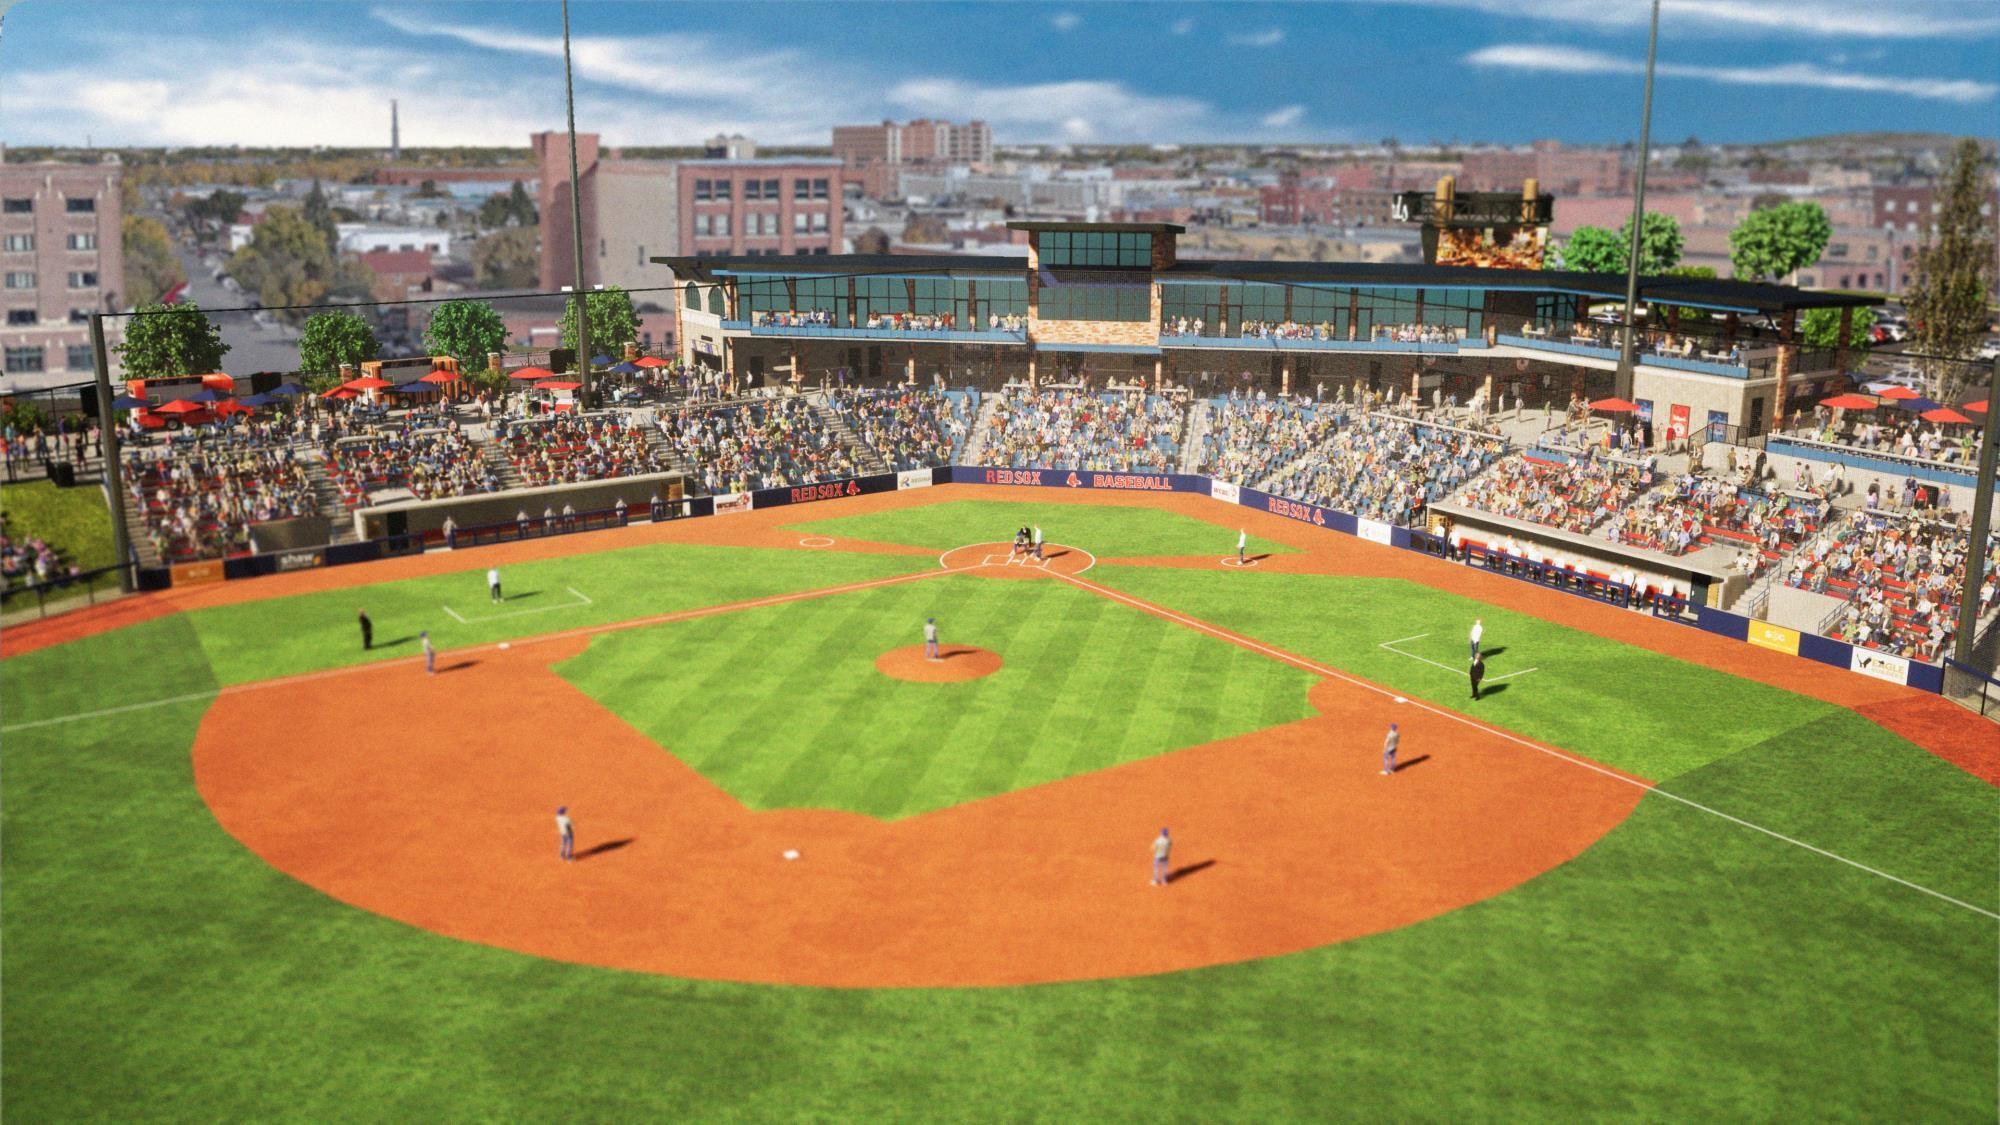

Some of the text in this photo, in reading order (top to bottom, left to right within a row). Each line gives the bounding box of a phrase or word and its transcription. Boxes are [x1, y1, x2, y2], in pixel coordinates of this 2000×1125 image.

[986, 470, 1041, 486] RED SOX
[1094, 474, 1172, 490] BASEBALL
[792, 483, 843, 502] RED SOX
[1268, 498, 1310, 522] RED SOX
